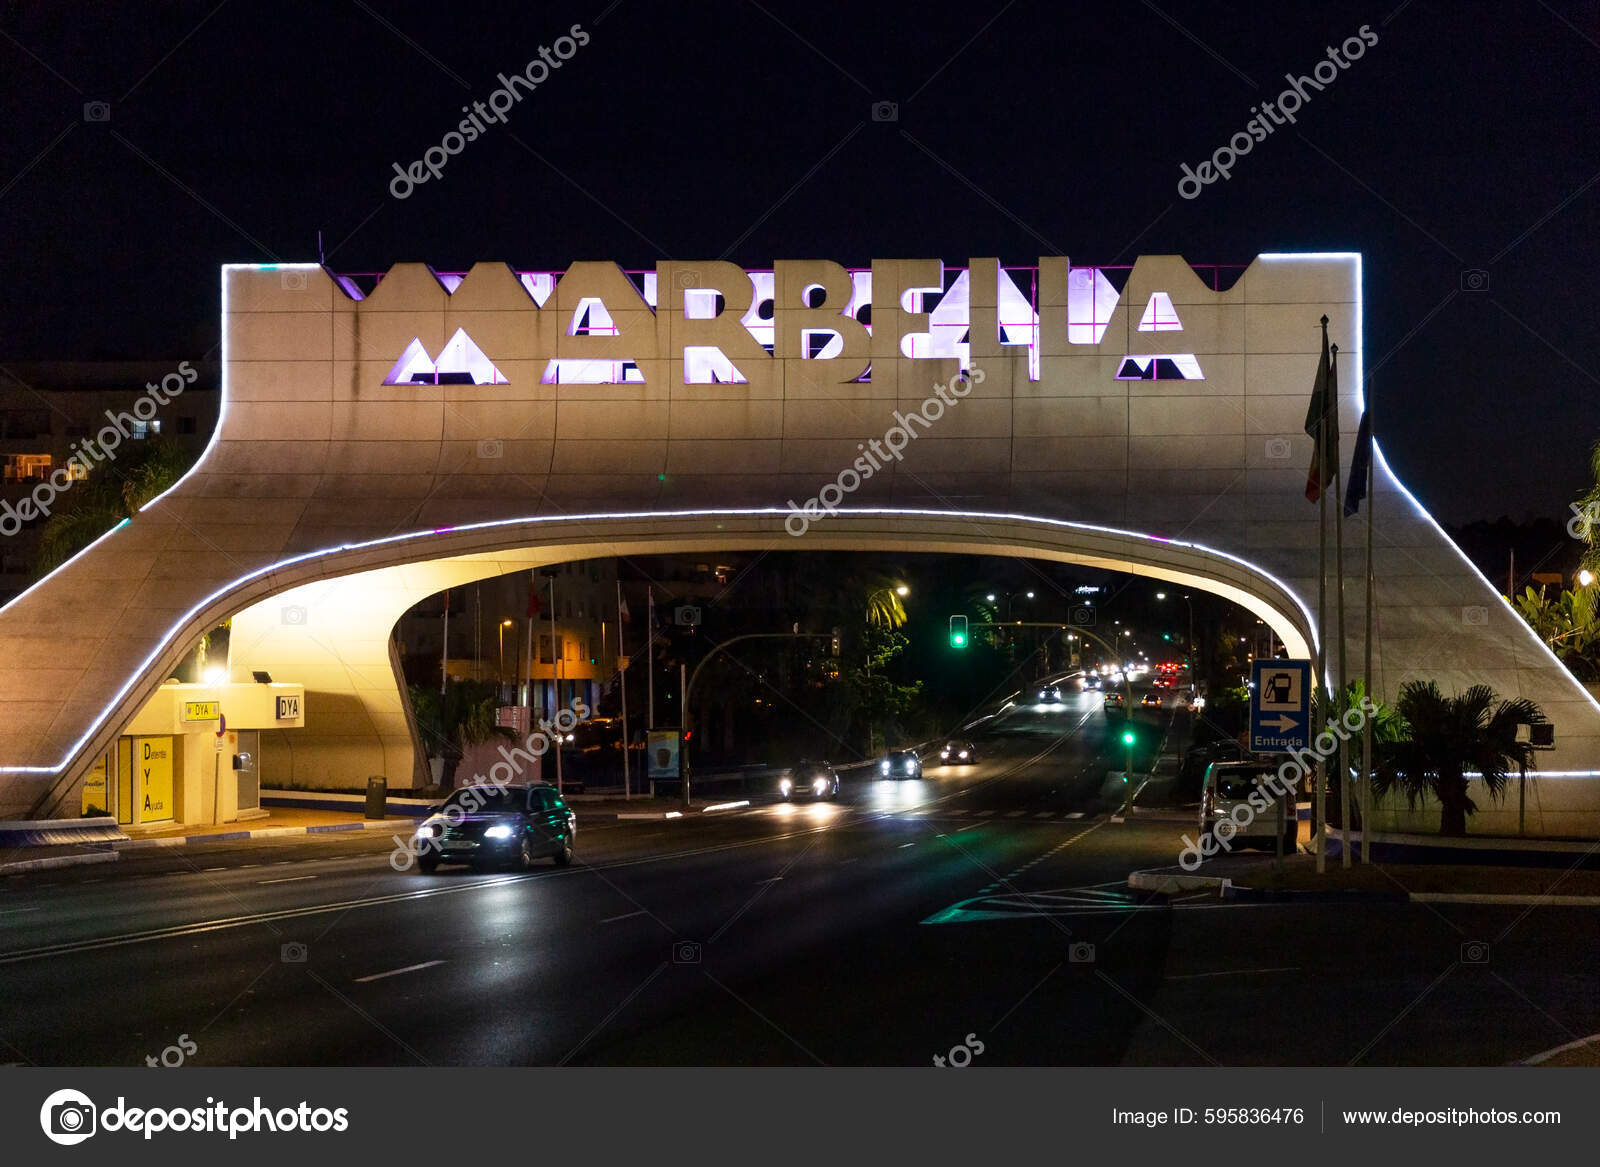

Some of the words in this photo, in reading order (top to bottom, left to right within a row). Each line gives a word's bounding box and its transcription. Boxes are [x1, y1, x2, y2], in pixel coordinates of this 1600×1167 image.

[362, 255, 1218, 386] MARBELLA
[195, 704, 209, 716] DYA
[281, 699, 298, 716] DYA
[1255, 735, 1303, 746] Entrada
